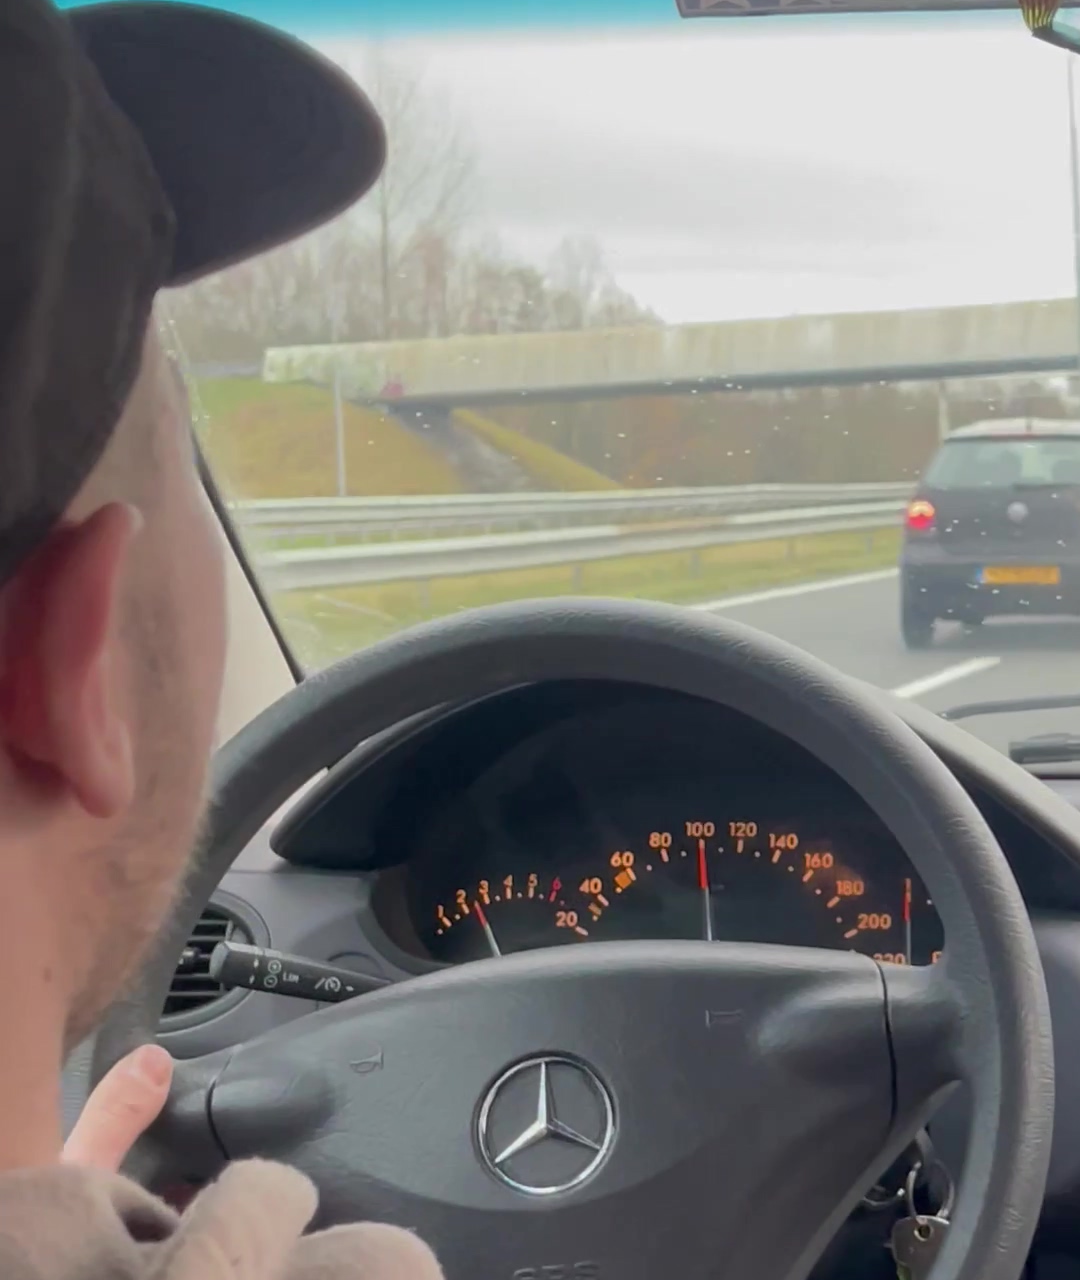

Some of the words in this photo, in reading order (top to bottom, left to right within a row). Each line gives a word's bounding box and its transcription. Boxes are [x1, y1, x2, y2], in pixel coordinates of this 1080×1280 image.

[685, 822, 715, 837] 100
[729, 822, 757, 837] 120
[649, 832, 672, 848] 80
[769, 833, 798, 849] 140
[610, 851, 634, 867] 60
[804, 853, 833, 868] 160
[479, 880, 489, 894] 3
[503, 874, 513, 887] 4
[528, 873, 538, 887] 5
[552, 876, 562, 890] 6
[579, 877, 602, 894] 40
[836, 880, 864, 895] 180
[456, 889, 466, 904] 2
[556, 911, 578, 927] 20
[858, 914, 891, 929] 200
